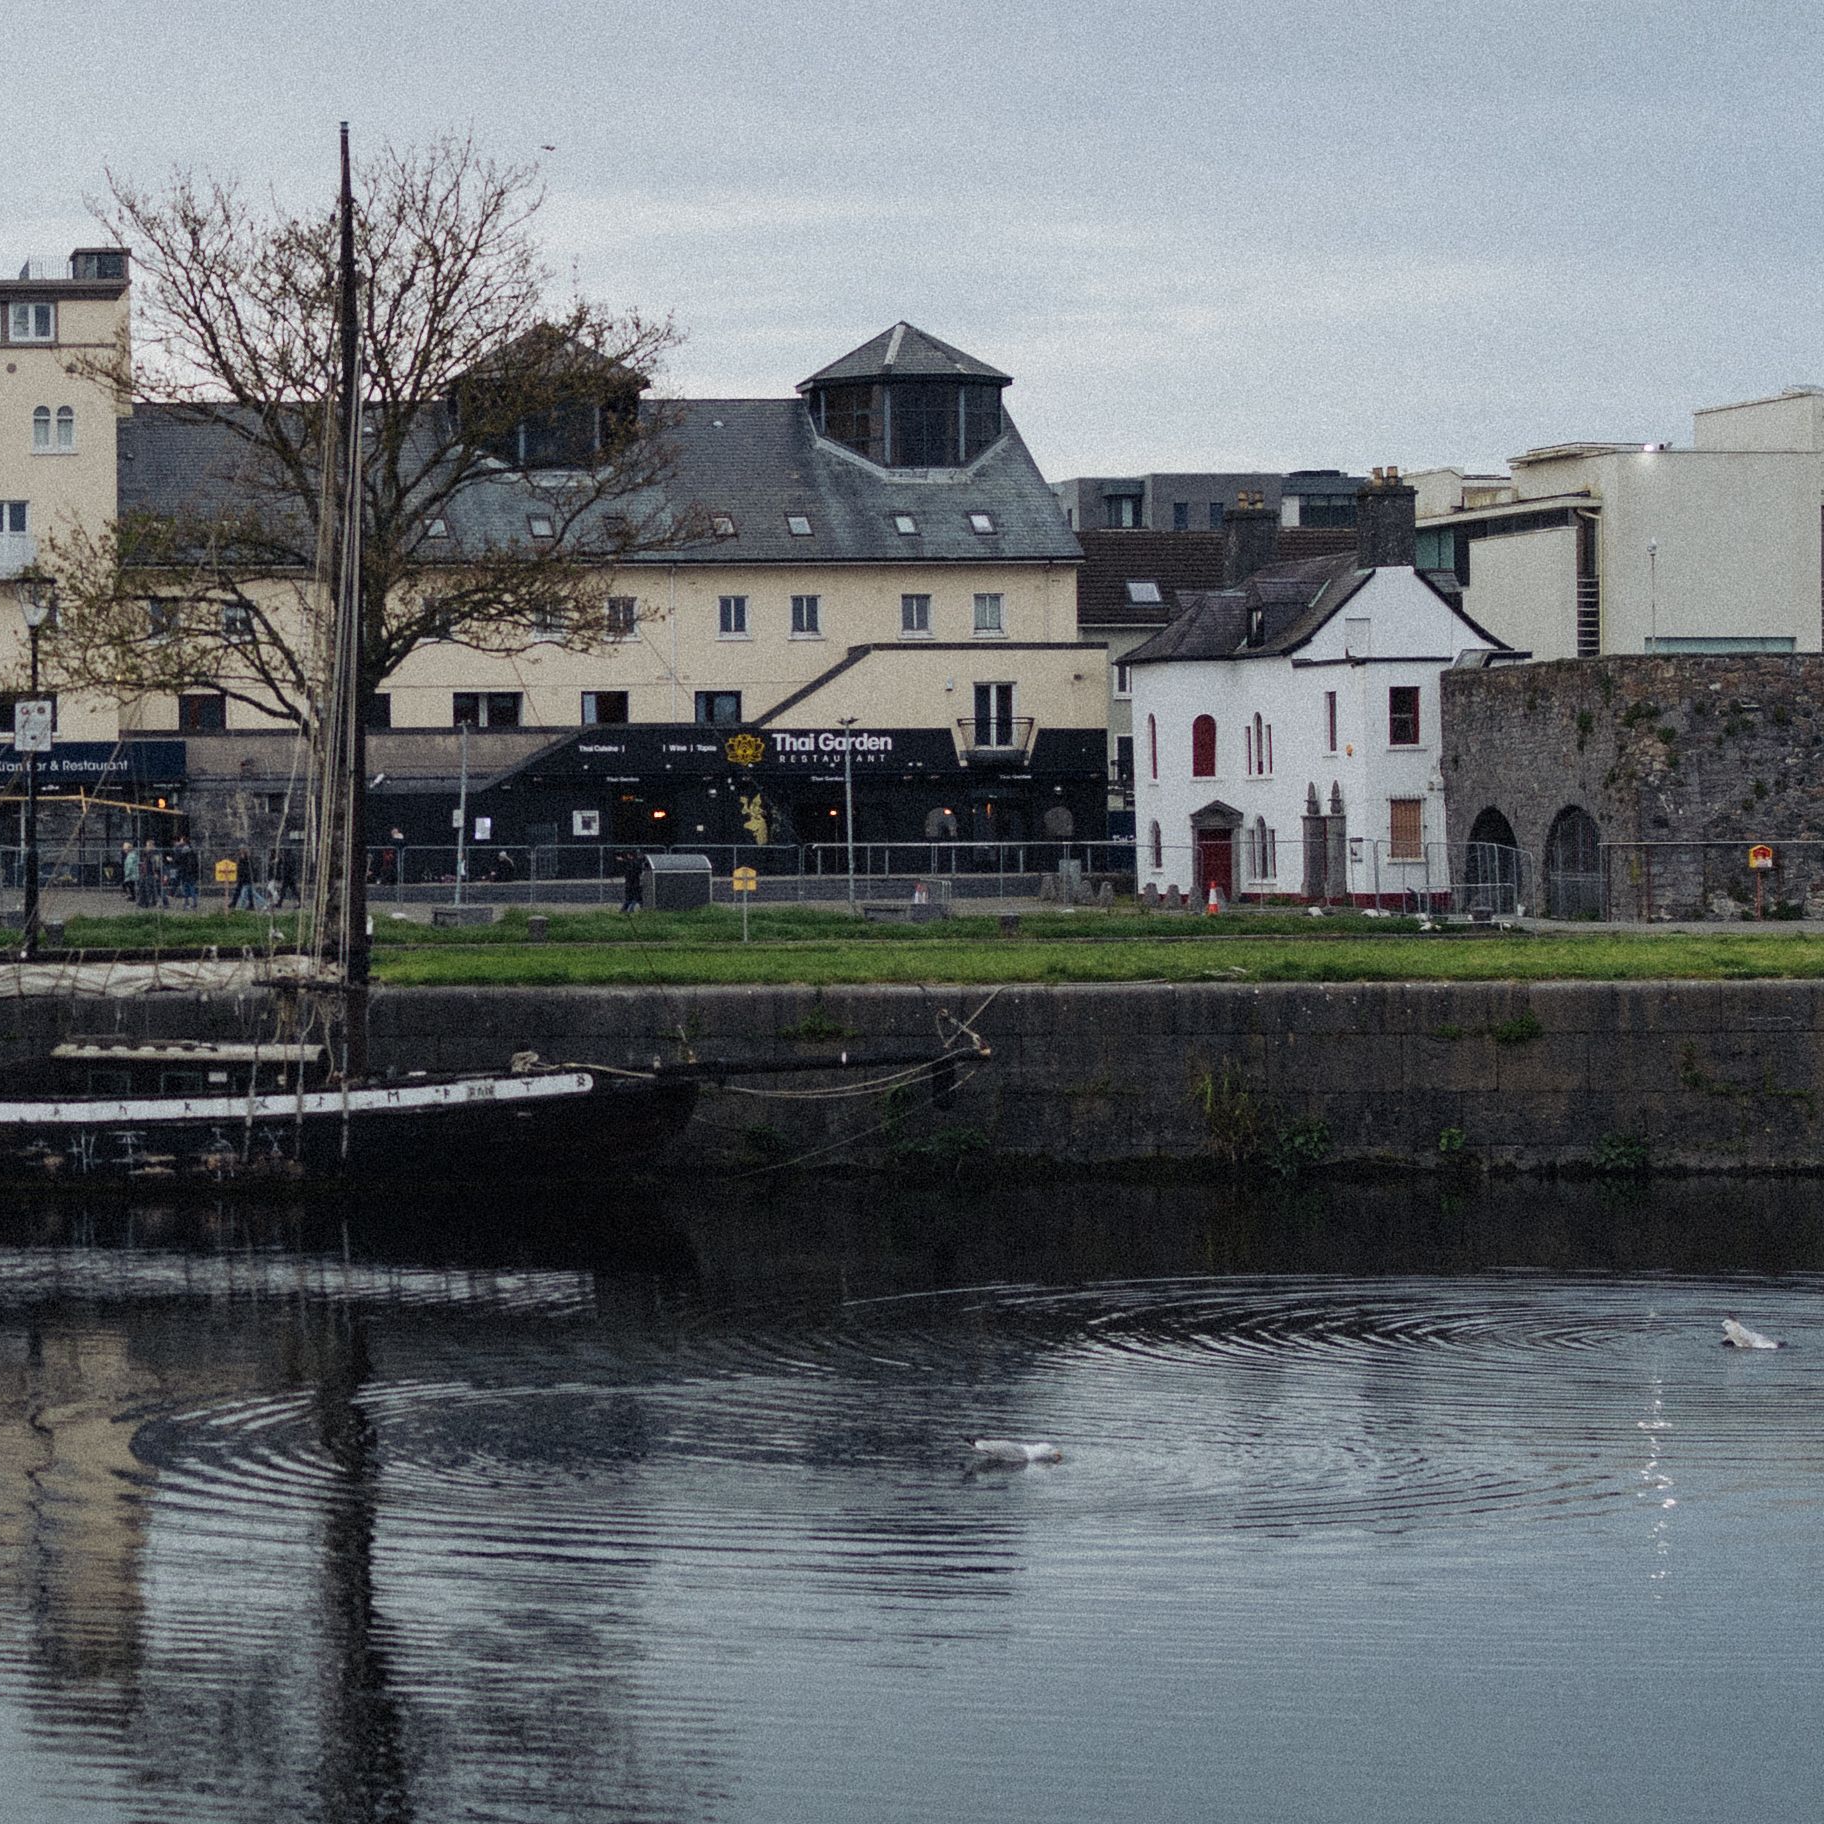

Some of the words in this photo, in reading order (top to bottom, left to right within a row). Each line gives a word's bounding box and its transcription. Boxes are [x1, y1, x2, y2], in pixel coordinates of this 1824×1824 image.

[772, 733, 815, 751] Thai
[819, 732, 893, 751] Garden
[62, 759, 128, 772] Restaurant
[778, 754, 887, 764] RESTAUANT
